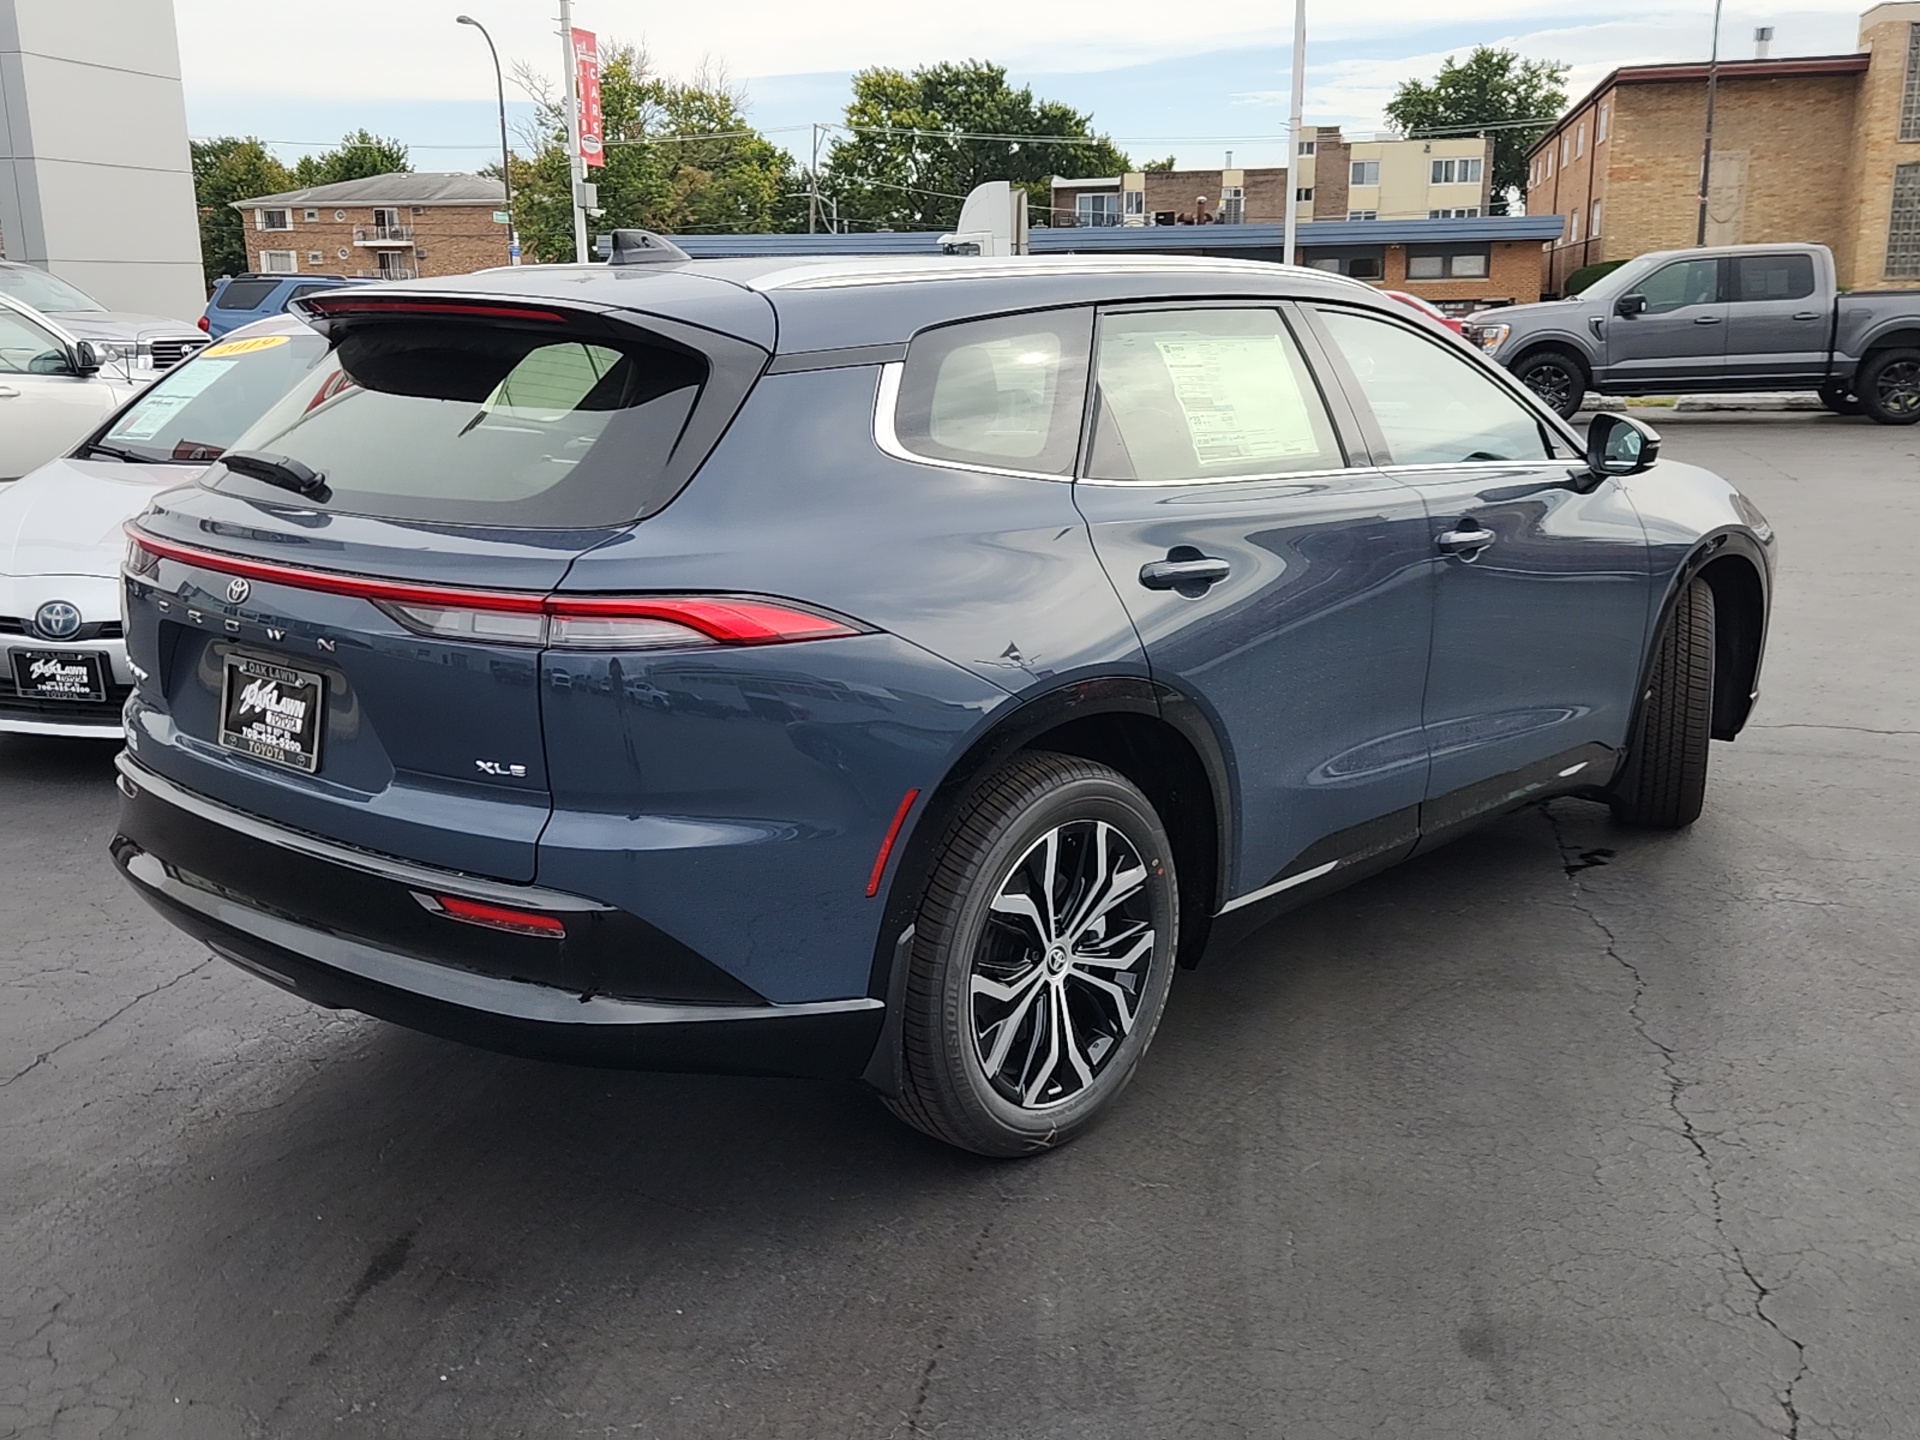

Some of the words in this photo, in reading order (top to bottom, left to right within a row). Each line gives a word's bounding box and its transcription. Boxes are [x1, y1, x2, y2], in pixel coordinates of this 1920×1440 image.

[589, 67, 599, 134] CARS
[157, 600, 336, 652] CROWN
[248, 662, 268, 677] OAK
[268, 667, 296, 683] LAWN
[270, 711, 298, 731] TOYOTA
[248, 740, 286, 760] TOYOTA
[475, 760, 526, 777] XLE
